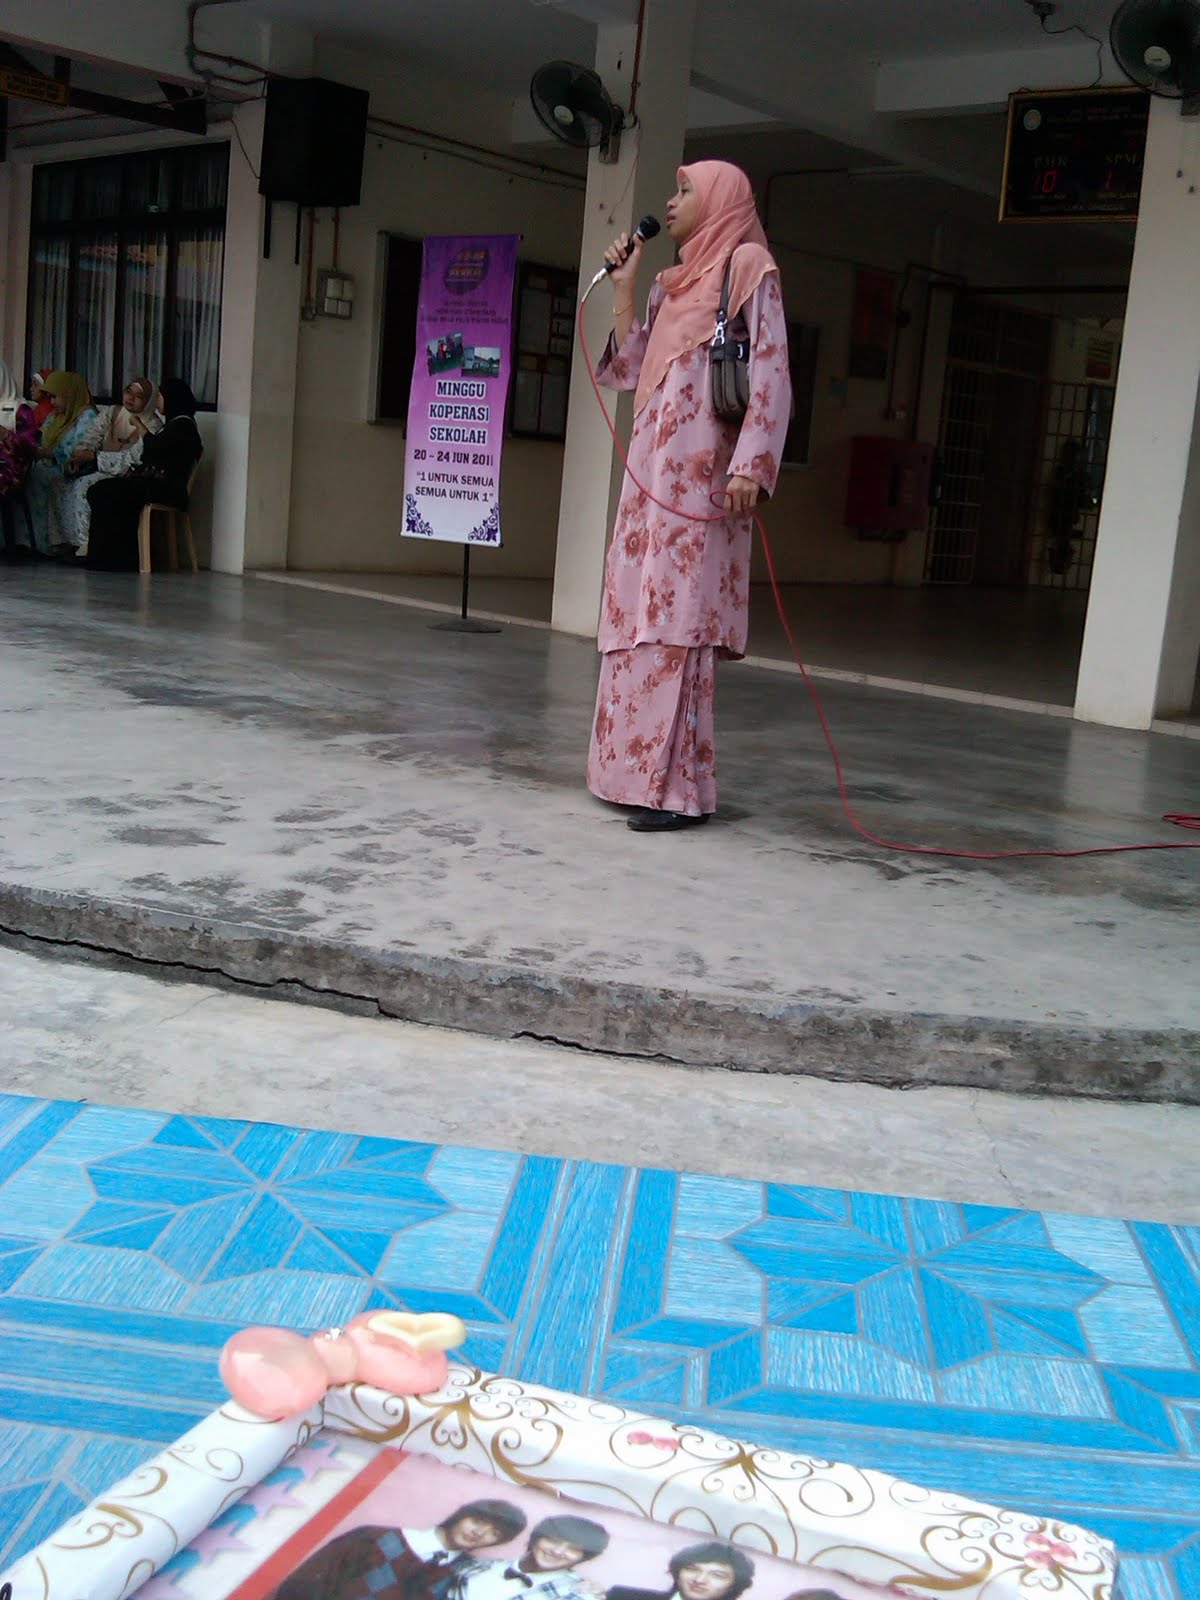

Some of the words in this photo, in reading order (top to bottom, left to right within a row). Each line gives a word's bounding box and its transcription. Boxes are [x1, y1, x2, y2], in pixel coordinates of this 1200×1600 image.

[437, 382, 485, 397] MINGGU
[429, 404, 489, 421] KOPERASI
[430, 427, 486, 444] SEKOLAH
[414, 449, 427, 460] 20
[437, 451, 450, 462] 24
[452, 452, 470, 464] JUN
[472, 454, 493, 466] 2011
[428, 473, 458, 484] UNTUK
[461, 475, 494, 487] SEMUA
[415, 486, 446, 498] SEMUA
[450, 489, 479, 502] UNTUK
